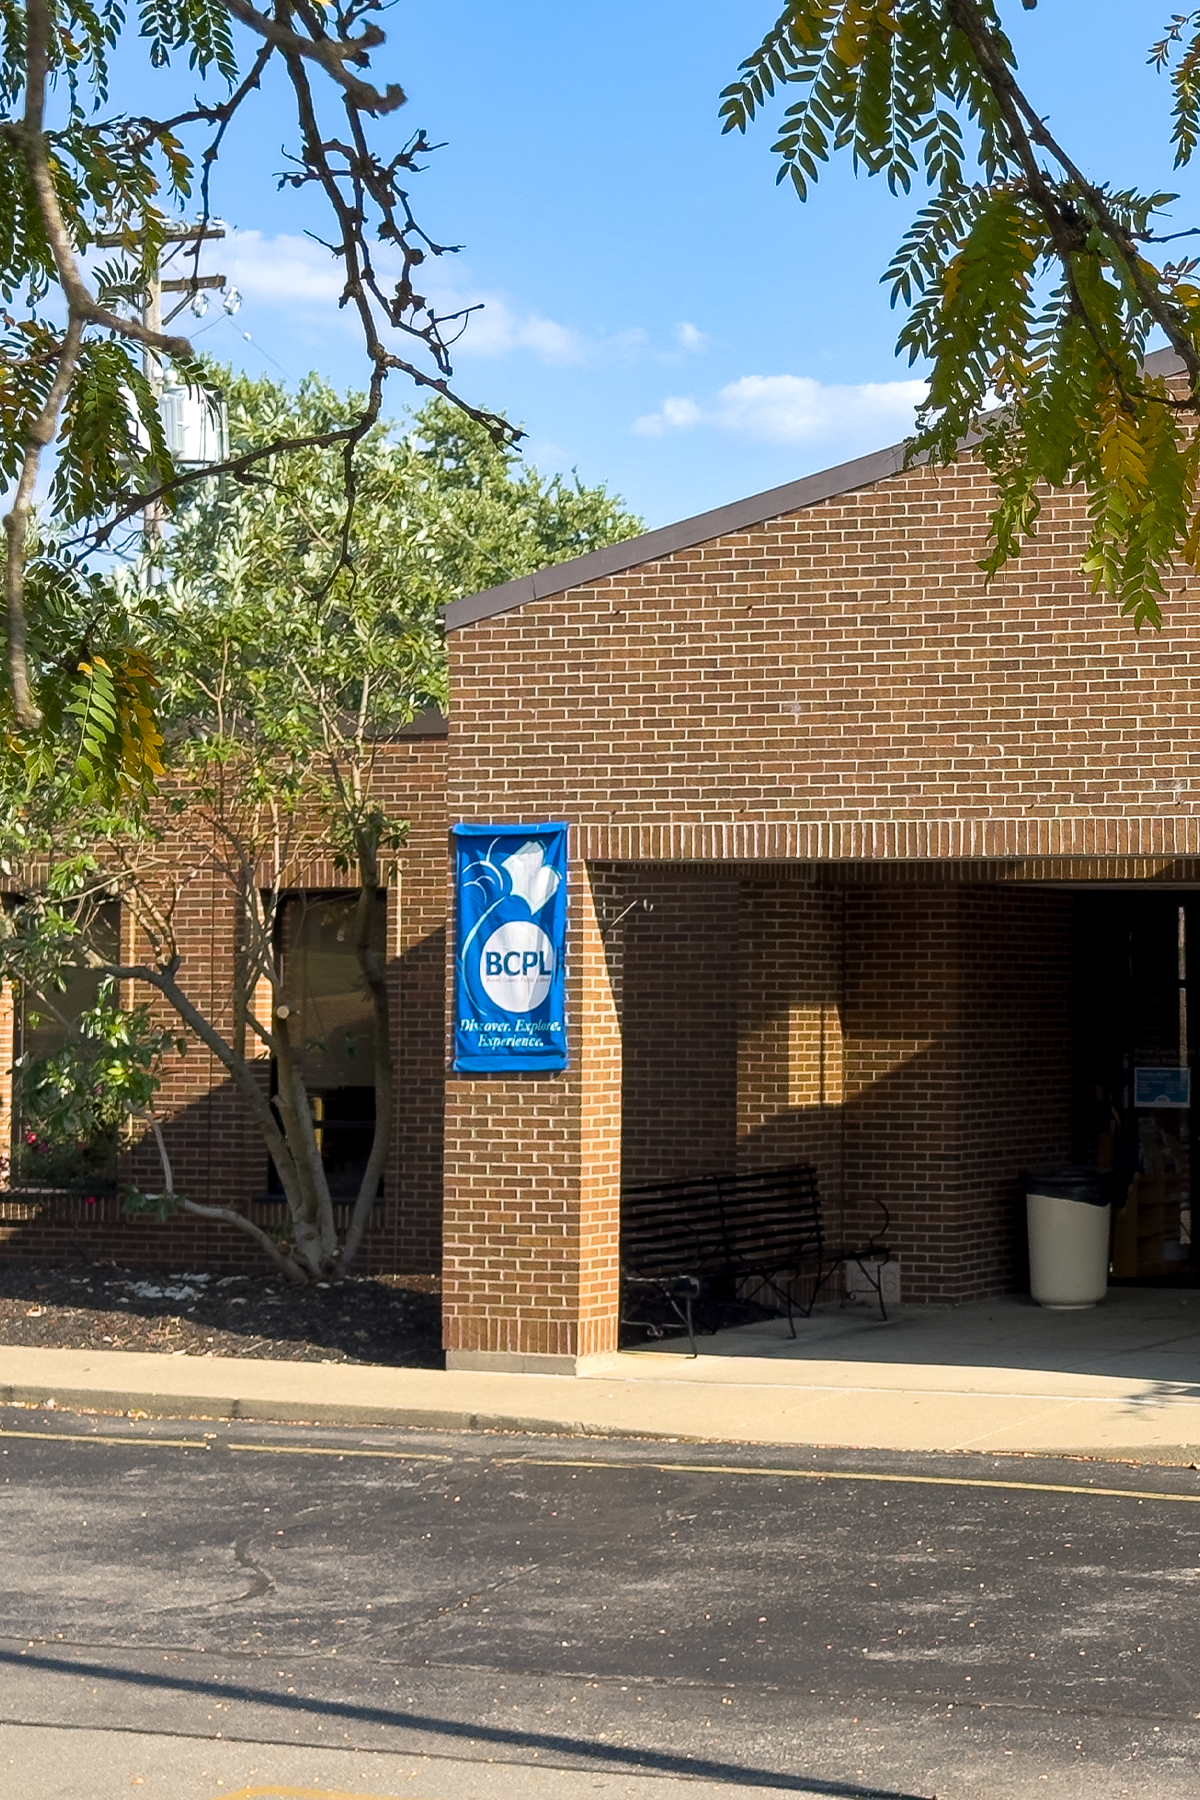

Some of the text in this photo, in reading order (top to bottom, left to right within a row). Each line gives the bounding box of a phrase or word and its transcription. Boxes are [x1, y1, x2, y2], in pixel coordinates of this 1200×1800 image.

[486, 951, 552, 976] BCPL
[515, 1018, 561, 1035] Explore.
[478, 1034, 544, 1050] Experience.
